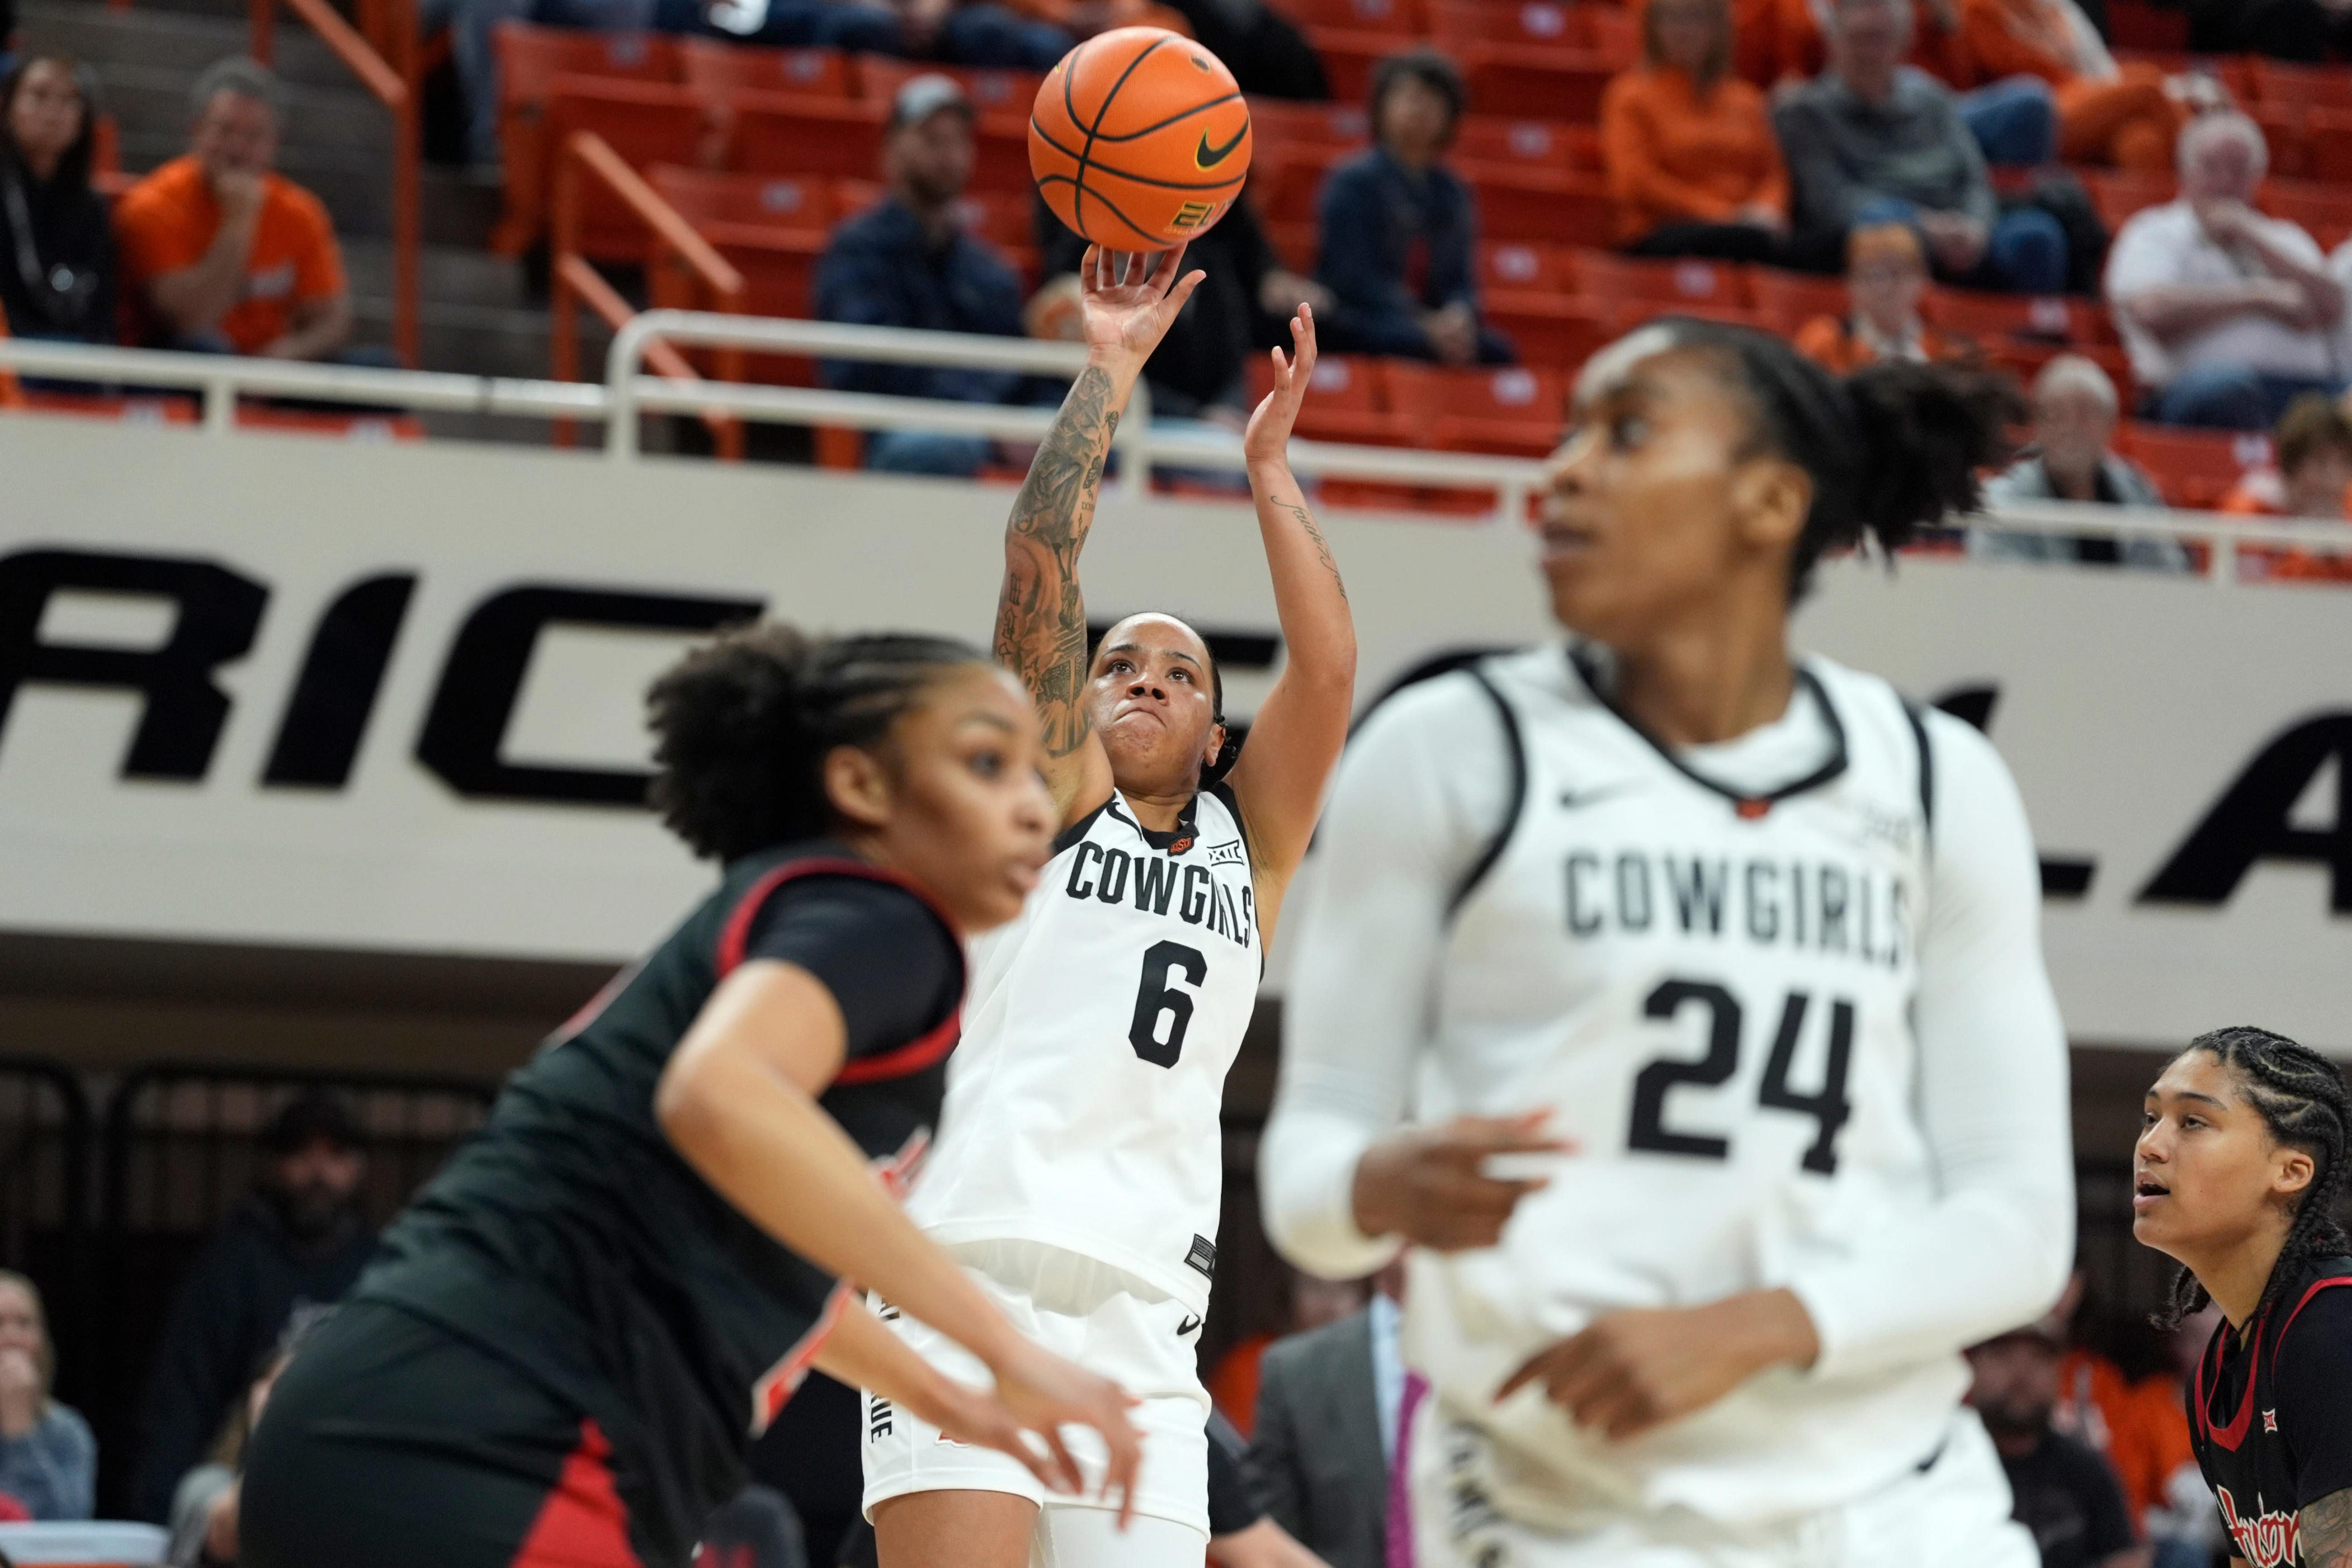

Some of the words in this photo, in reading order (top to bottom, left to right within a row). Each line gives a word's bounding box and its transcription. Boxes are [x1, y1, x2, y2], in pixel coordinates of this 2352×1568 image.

[1067, 841, 1253, 949] COWGIRLS
[1564, 848, 1908, 972] COWGIRLS
[1128, 939, 1207, 1069] 6
[1627, 977, 1855, 1177] 24
